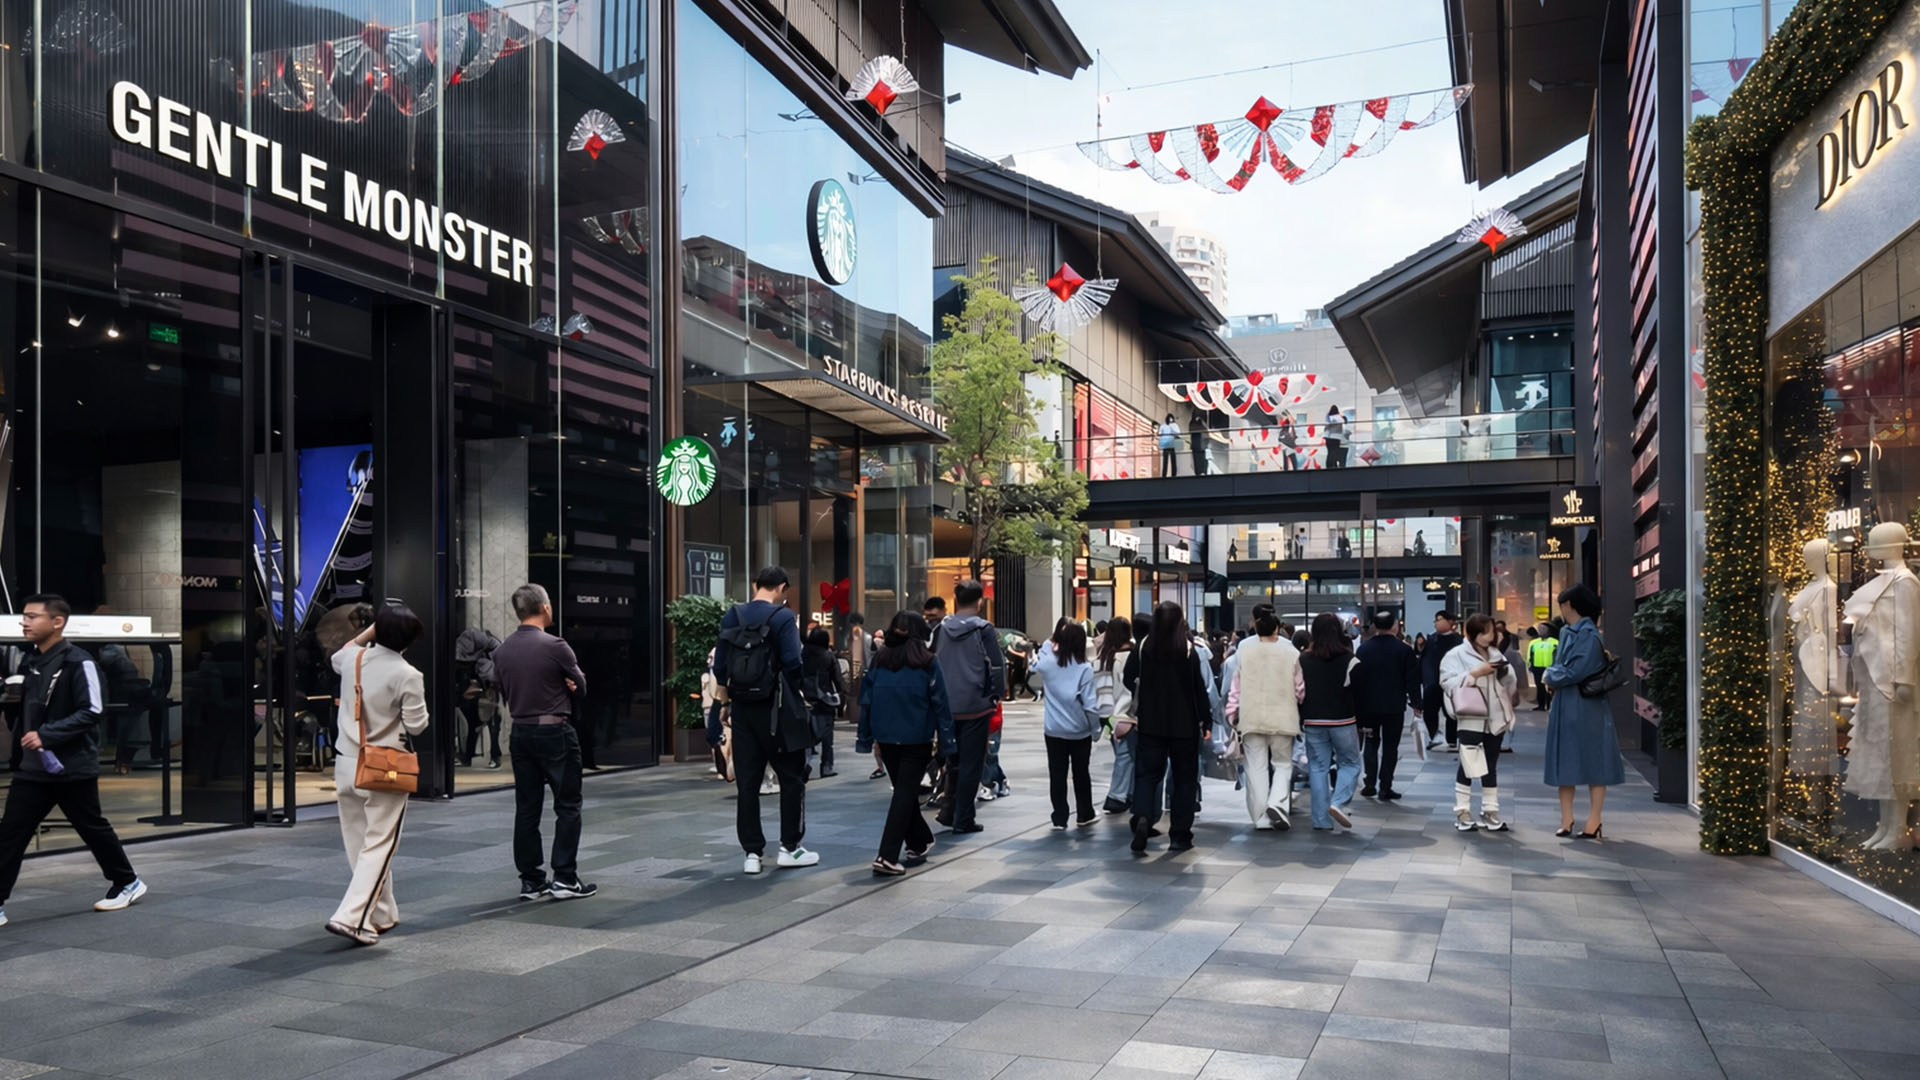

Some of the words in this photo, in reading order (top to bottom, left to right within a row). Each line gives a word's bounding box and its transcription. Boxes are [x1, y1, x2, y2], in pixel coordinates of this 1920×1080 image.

[111, 80, 328, 213] GENTLE
[343, 170, 534, 288] MONSTER
[1814, 60, 1909, 210] DIOR
